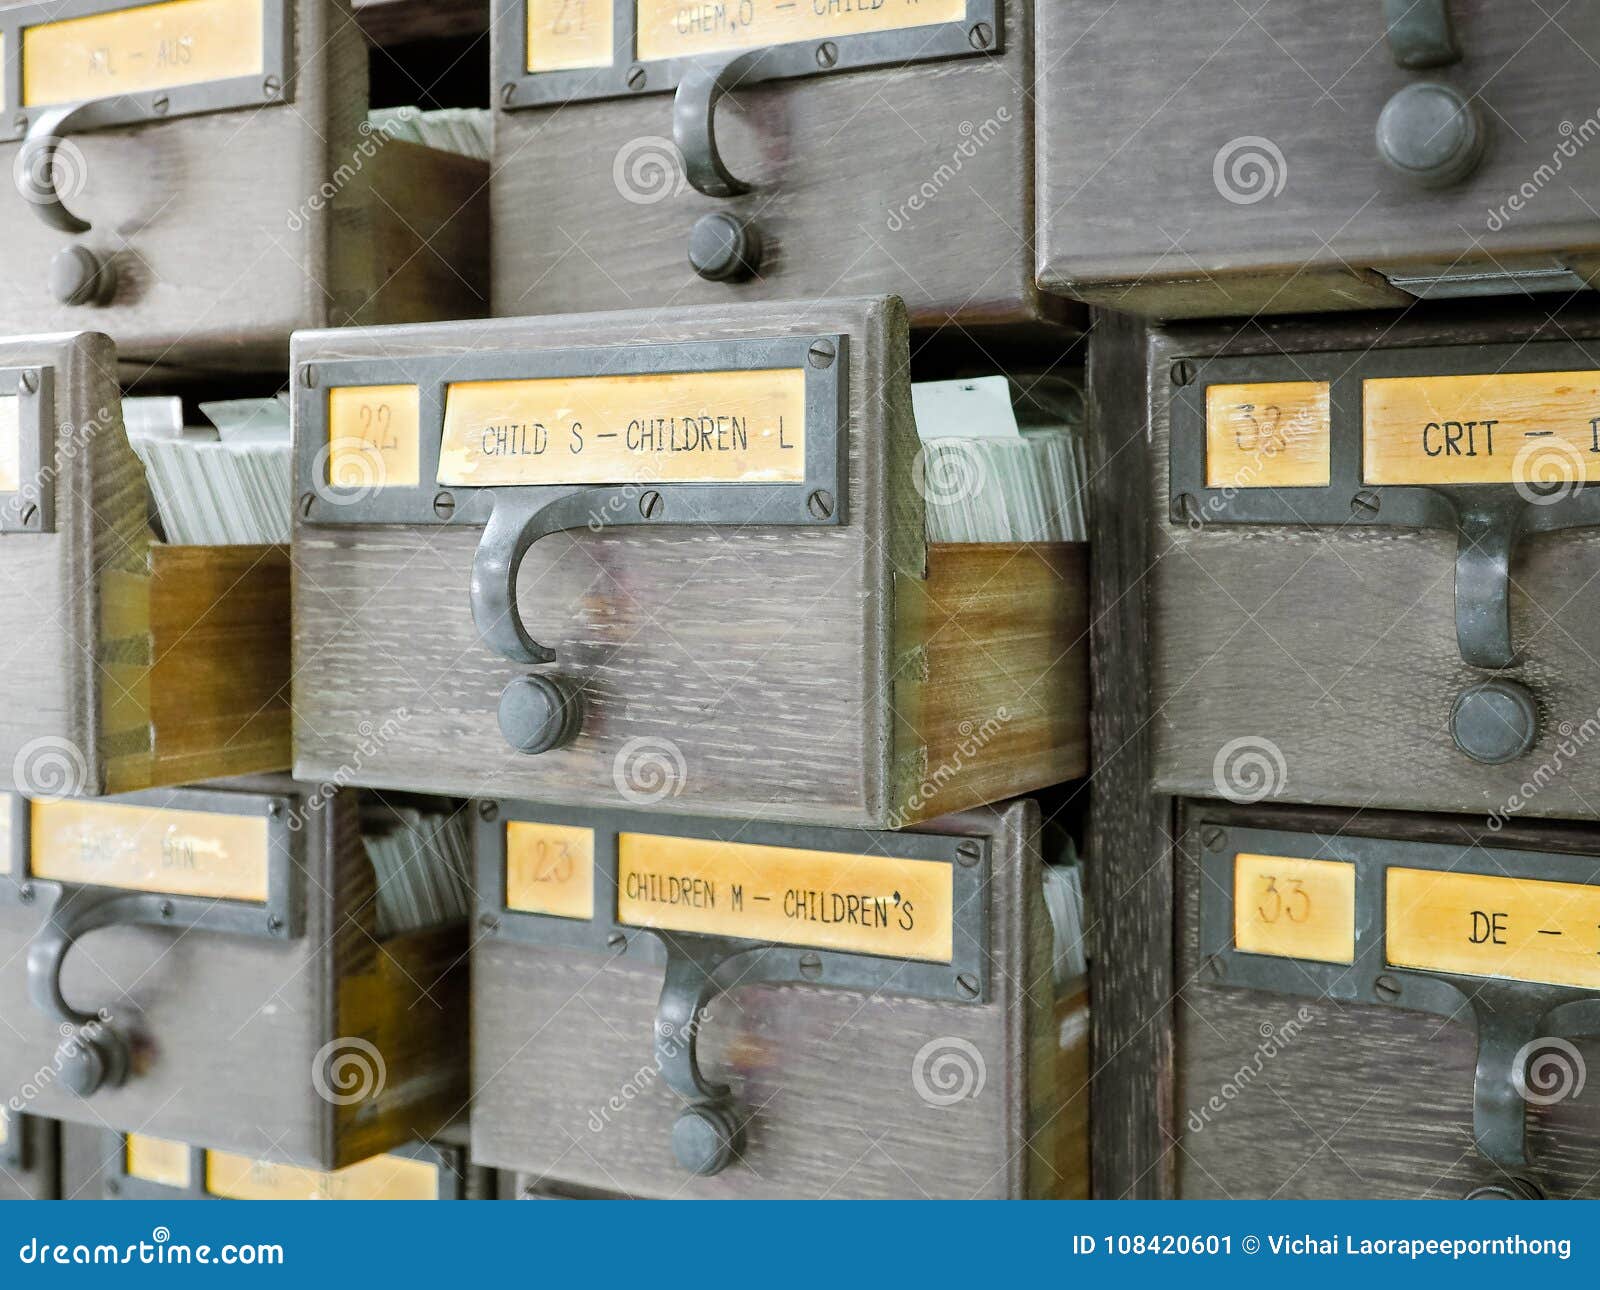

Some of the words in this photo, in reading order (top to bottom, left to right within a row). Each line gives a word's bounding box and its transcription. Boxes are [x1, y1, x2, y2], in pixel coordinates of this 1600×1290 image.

[359, 404, 398, 452] 22
[482, 423, 547, 455] CHILD
[570, 422, 584, 454] S
[626, 415, 748, 451] CHILDREN
[780, 416, 794, 449] L
[1423, 420, 1499, 456] CRIT
[534, 839, 574, 882] 23
[627, 872, 715, 908] CHILDREN
[732, 884, 743, 912] M
[784, 889, 914, 931] CHILDREN'S
[1258, 874, 1311, 924] 33
[1469, 911, 1508, 944] DE
